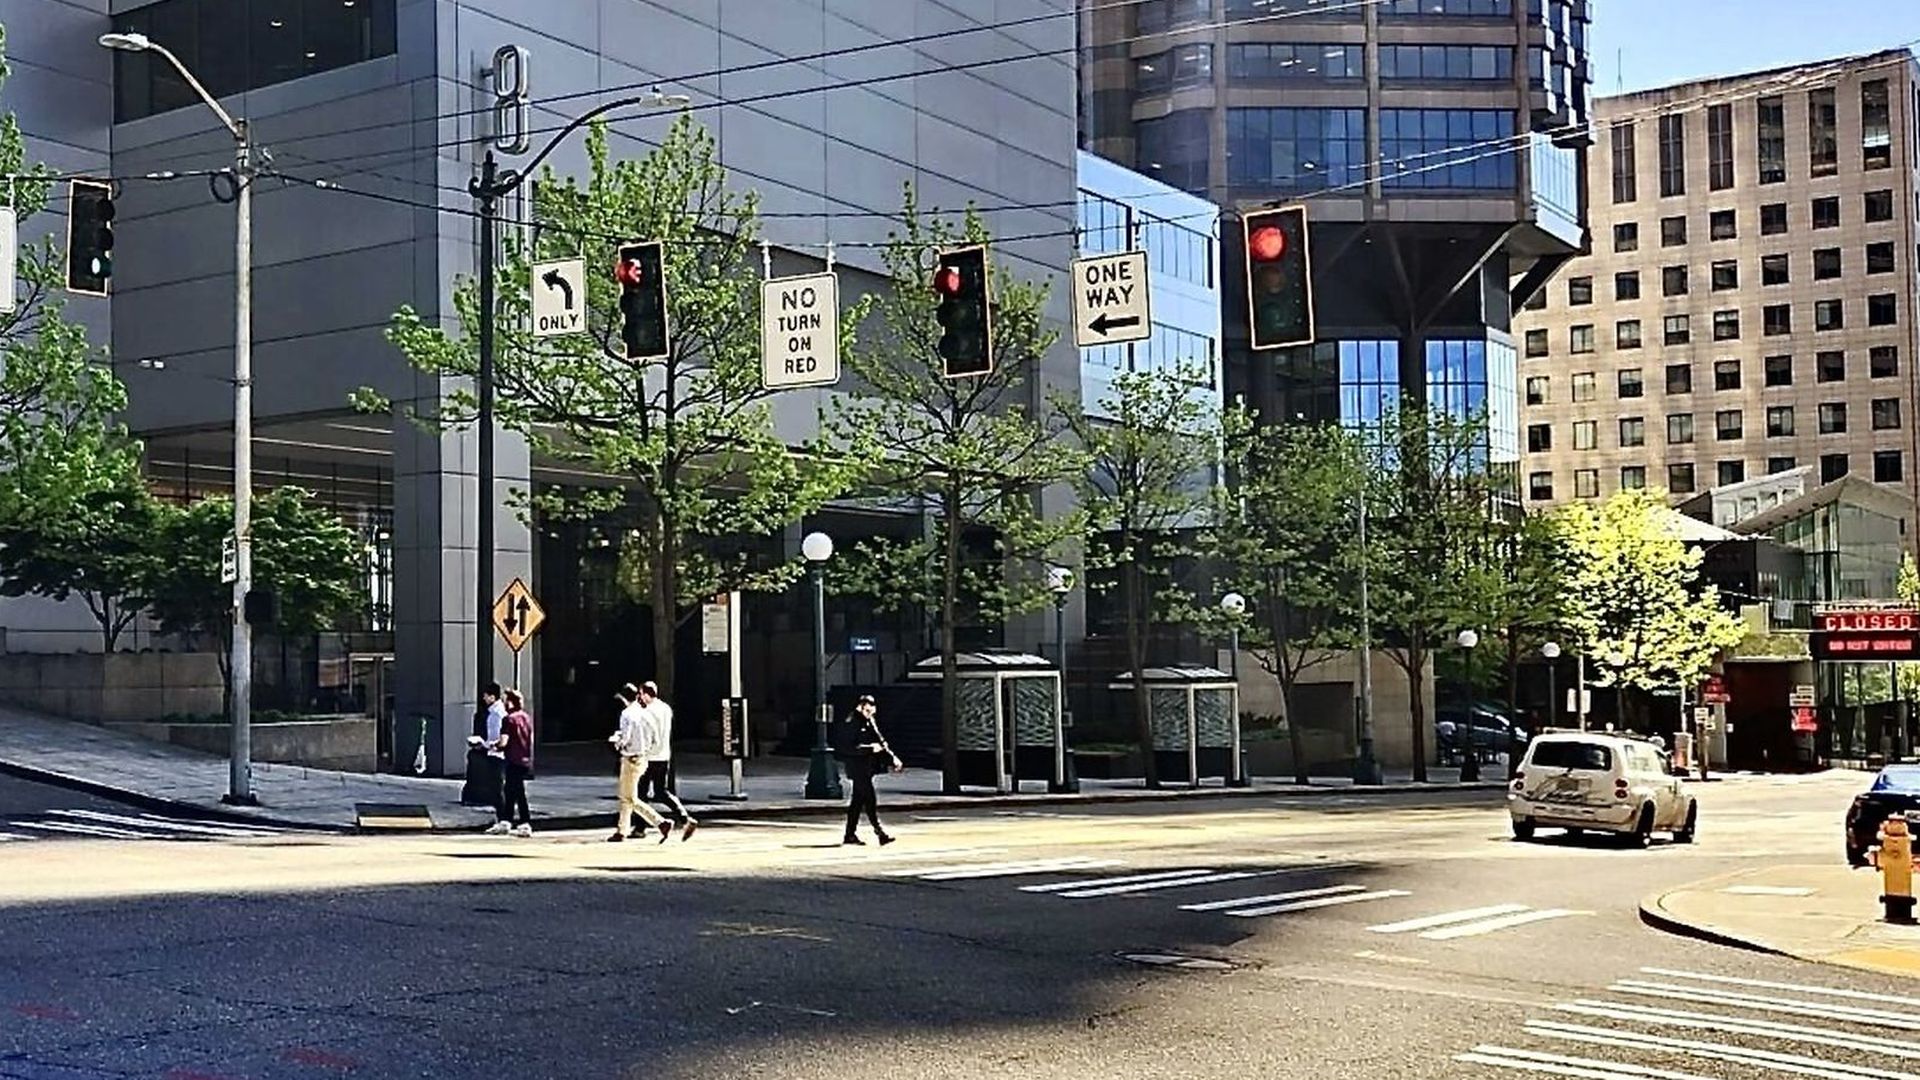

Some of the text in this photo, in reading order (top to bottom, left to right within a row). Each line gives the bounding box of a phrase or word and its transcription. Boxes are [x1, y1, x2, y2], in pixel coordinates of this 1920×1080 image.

[1086, 261, 1132, 284] ONE
[782, 287, 816, 310] NO
[1086, 284, 1134, 308] WAY
[539, 313, 579, 331] ONLY
[777, 313, 821, 332] TURN
[788, 336, 811, 352] ON
[785, 356, 817, 374] RED
[1825, 615, 1912, 631] CLOSED
